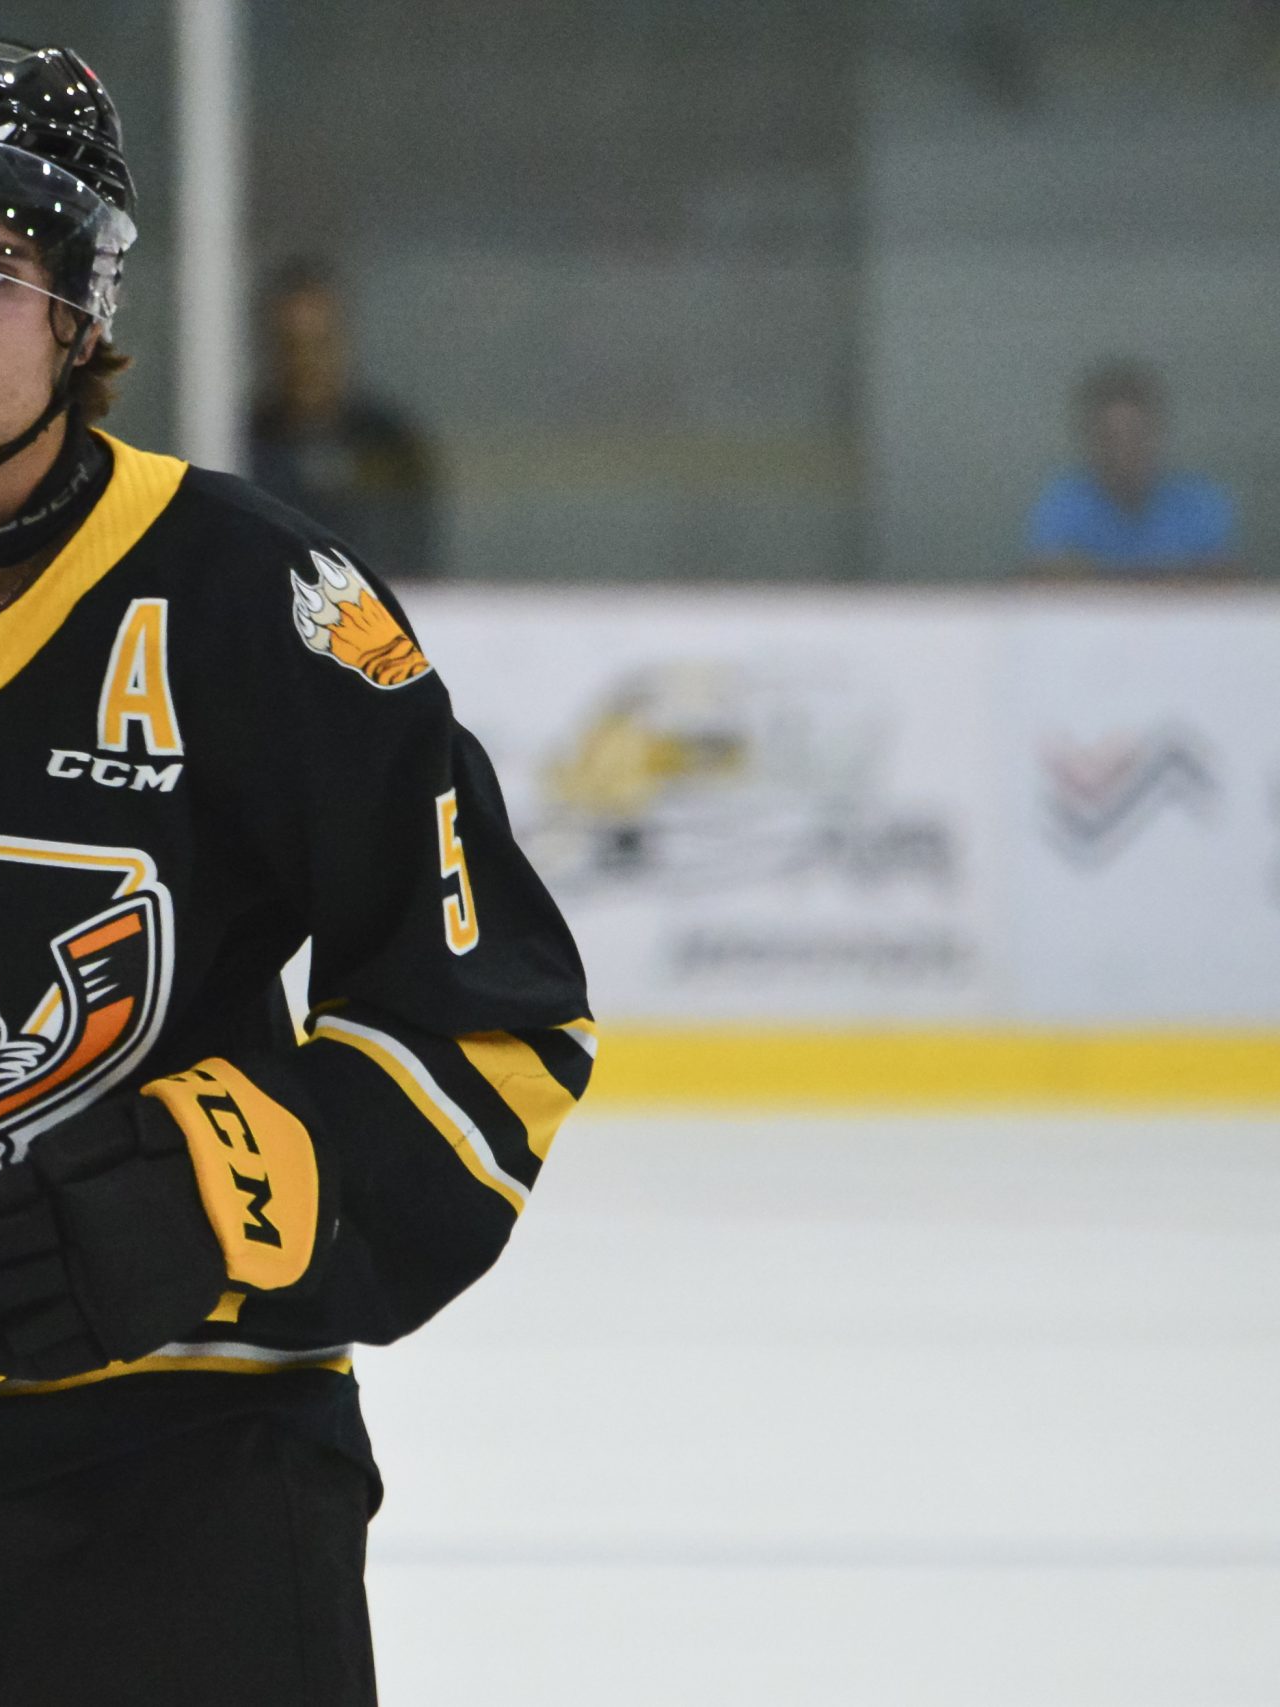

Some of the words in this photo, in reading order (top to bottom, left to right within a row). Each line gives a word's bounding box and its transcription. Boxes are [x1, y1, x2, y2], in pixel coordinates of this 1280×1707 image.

[97, 598, 184, 756] A
[46, 749, 184, 793] CCM
[435, 786, 480, 957] 5
